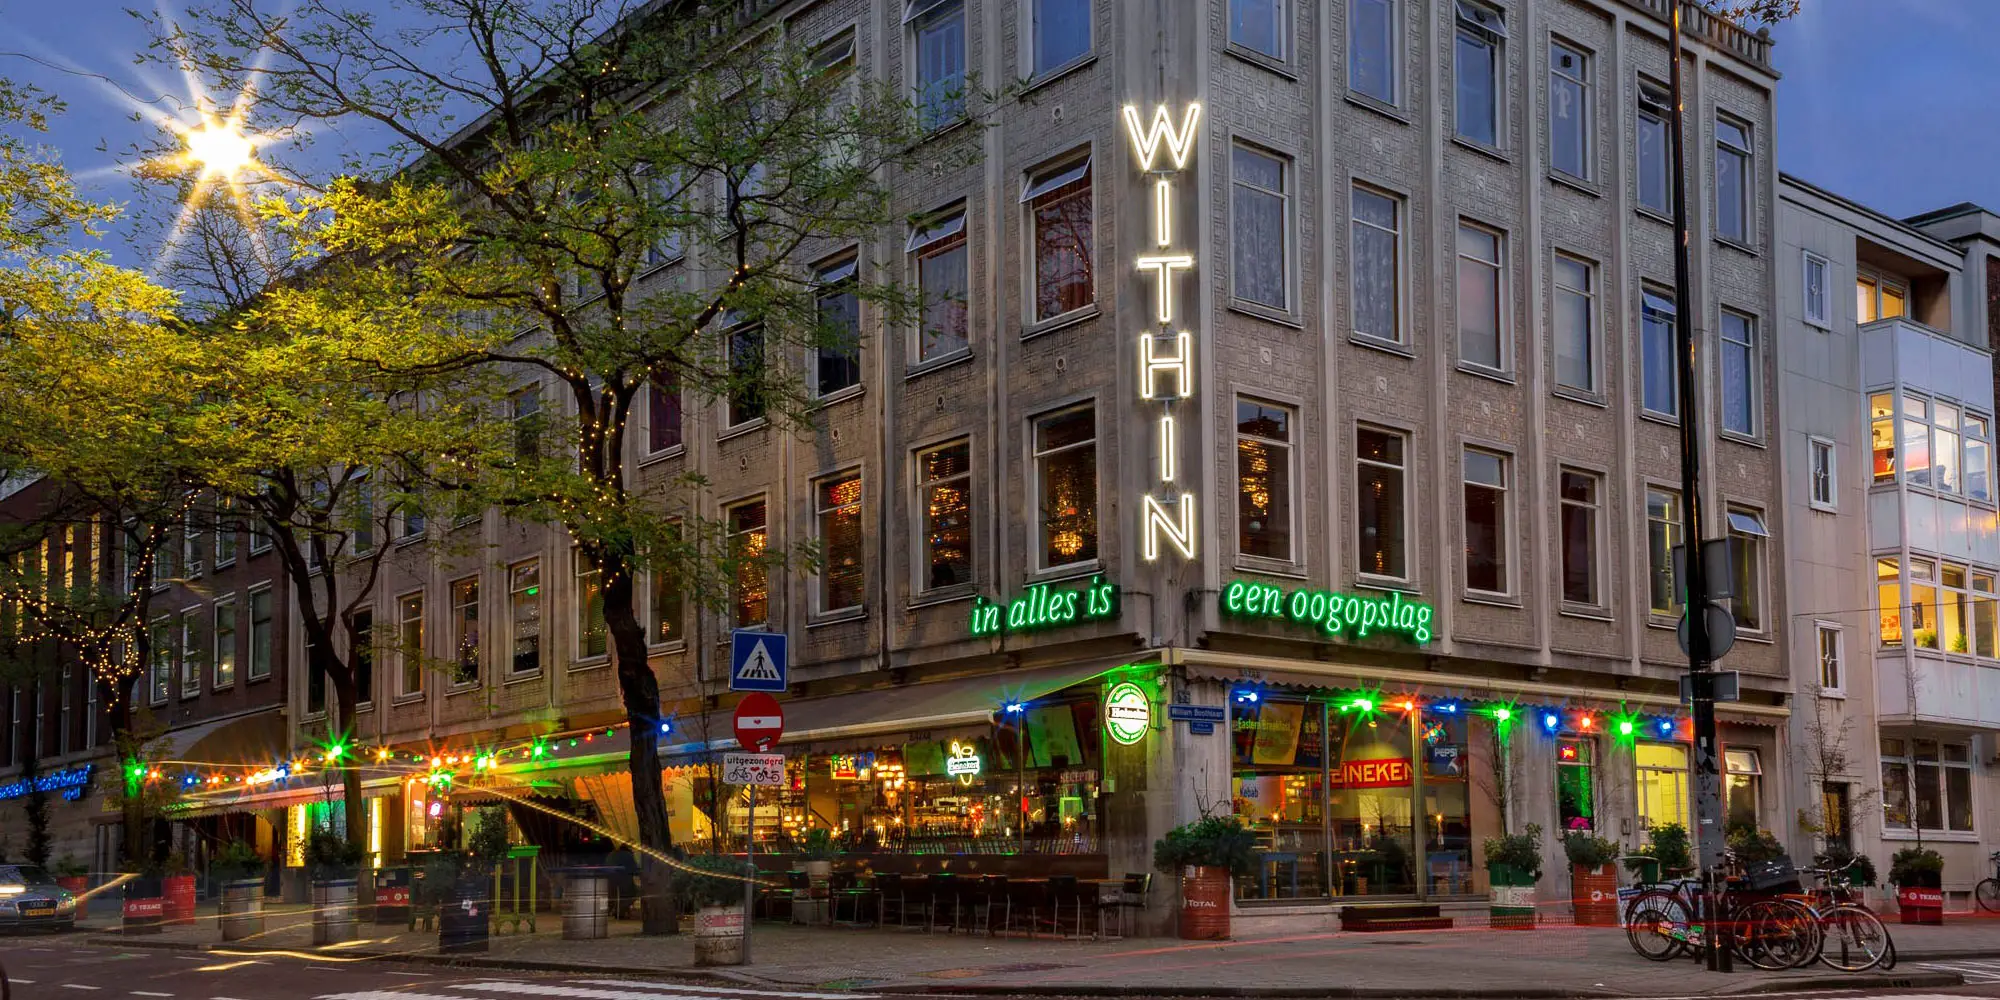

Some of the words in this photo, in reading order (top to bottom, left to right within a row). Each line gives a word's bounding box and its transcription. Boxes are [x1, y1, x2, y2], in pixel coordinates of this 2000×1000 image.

[1123, 103, 1201, 560] WITHIN
[972, 595, 999, 634] in
[1009, 583, 1077, 628] alles
[1087, 577, 1113, 616] is
[1229, 580, 1281, 615] een
[1292, 591, 1432, 643] oogopslag
[726, 757, 784, 768] uitgezonderd
[1322, 761, 1413, 784] EINEKEN
[1434, 747, 1458, 758] PEPSI
